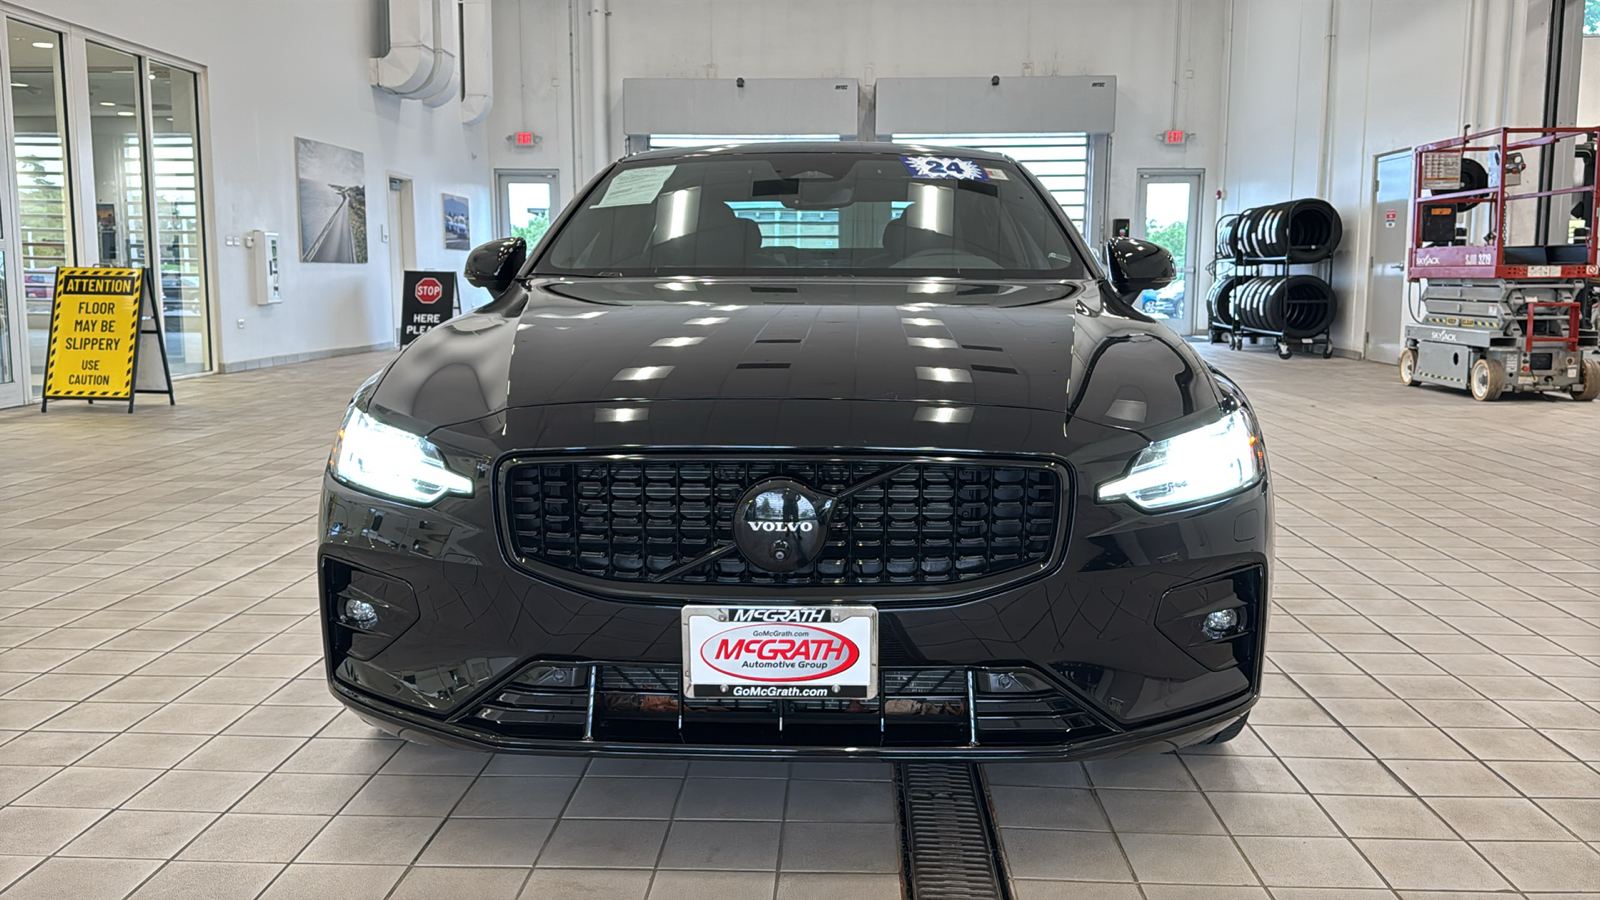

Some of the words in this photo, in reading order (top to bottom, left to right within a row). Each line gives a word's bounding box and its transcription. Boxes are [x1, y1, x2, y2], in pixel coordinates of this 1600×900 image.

[516, 132, 532, 145] EXIT
[1167, 130, 1183, 144] EXIT
[925, 160, 965, 175] 24
[66, 278, 132, 293] ATTENTION
[417, 285, 440, 296] STOP
[78, 301, 115, 315] FLOOR
[413, 313, 441, 323] HERE
[74, 319, 97, 333] MAY
[101, 319, 116, 333] BE
[406, 325, 433, 335] PLEA
[65, 337, 121, 351] SLIPPERY
[81, 359, 100, 371] USE
[68, 374, 110, 386] CAUTION
[747, 521, 813, 532] VOLVO
[753, 630, 809, 638] GoMcGrath.com
[741, 660, 796, 669] Automotive
[798, 660, 828, 670] Group
[733, 687, 828, 697] GoMcGrath.com
